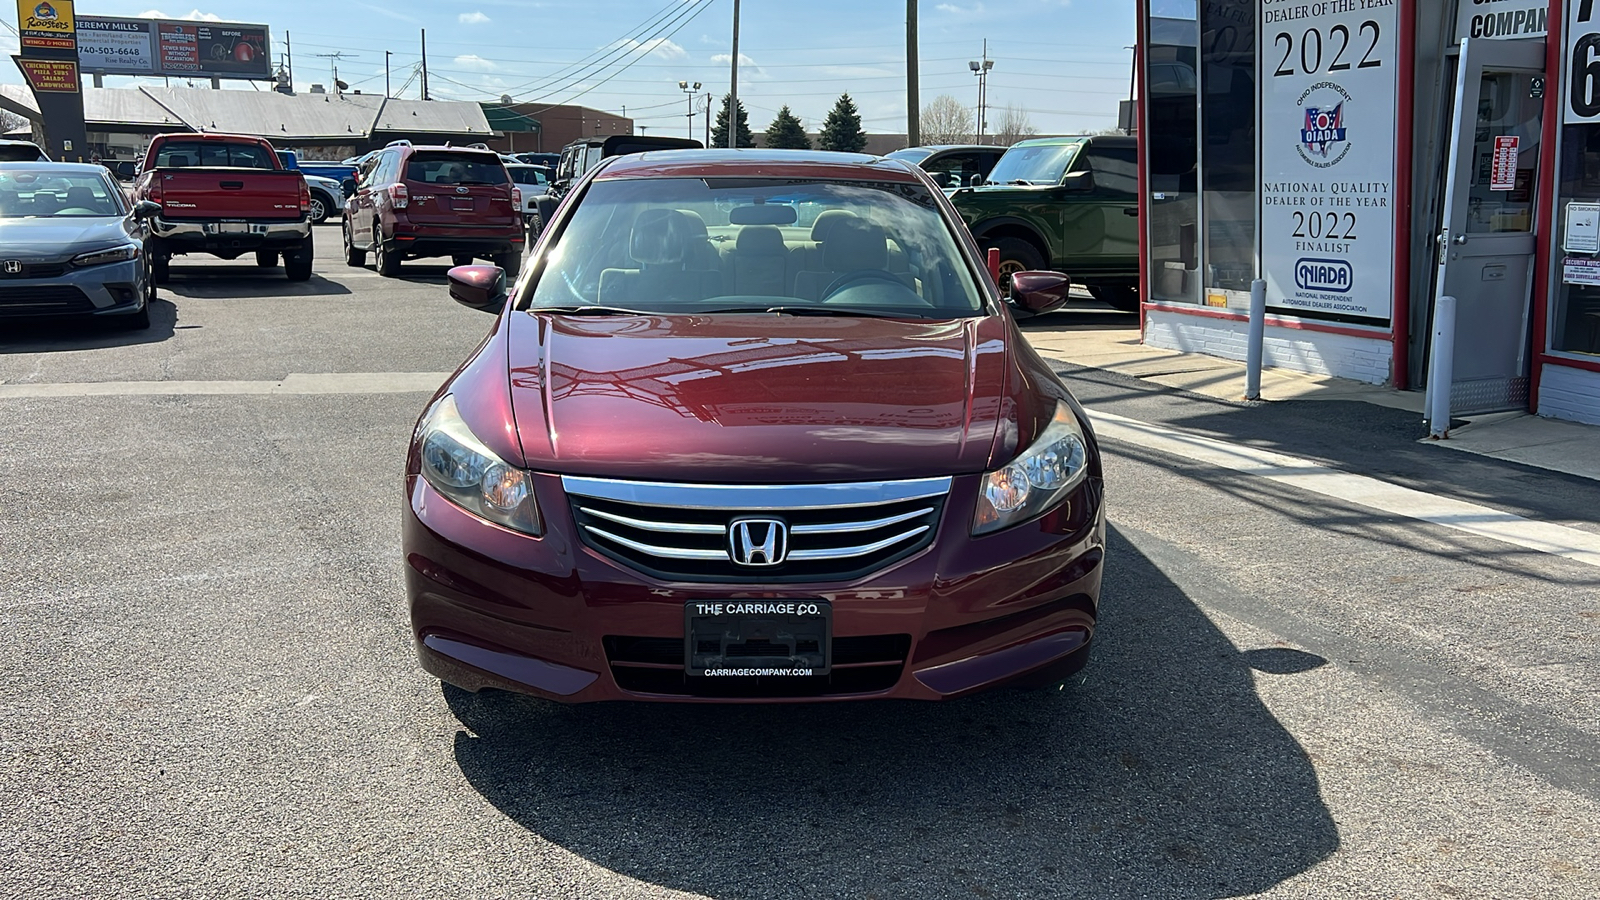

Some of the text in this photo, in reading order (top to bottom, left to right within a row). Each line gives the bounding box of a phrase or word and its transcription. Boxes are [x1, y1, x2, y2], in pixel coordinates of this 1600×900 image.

[1265, 0, 1392, 23] DEALER OF THE YEAR
[25, 16, 69, 30] Roosters
[112, 23, 139, 31] MILLS
[78, 46, 140, 56] 740-503-6648
[1274, 20, 1381, 77] 2022
[118, 57, 138, 66] Realty
[1296, 81, 1353, 107] OHIO INDEPENDENT
[1306, 129, 1339, 142] OIADA
[1264, 182, 1389, 195] NATIONAL QUALITY
[1265, 196, 1388, 208] DEALER OF THE YEAR
[1291, 210, 1357, 241] 2022
[1295, 241, 1351, 254] FINALIST
[1299, 264, 1347, 286] NIADA
[1295, 291, 1353, 303] NATIONAL INDEPENDENT
[1282, 298, 1368, 314] AUTOMOBILE DEALERS ASSOCIATION
[696, 604, 821, 615] THE CARRIAGE CO.
[704, 668, 813, 677] CARRIAGECOMPANY.COM
